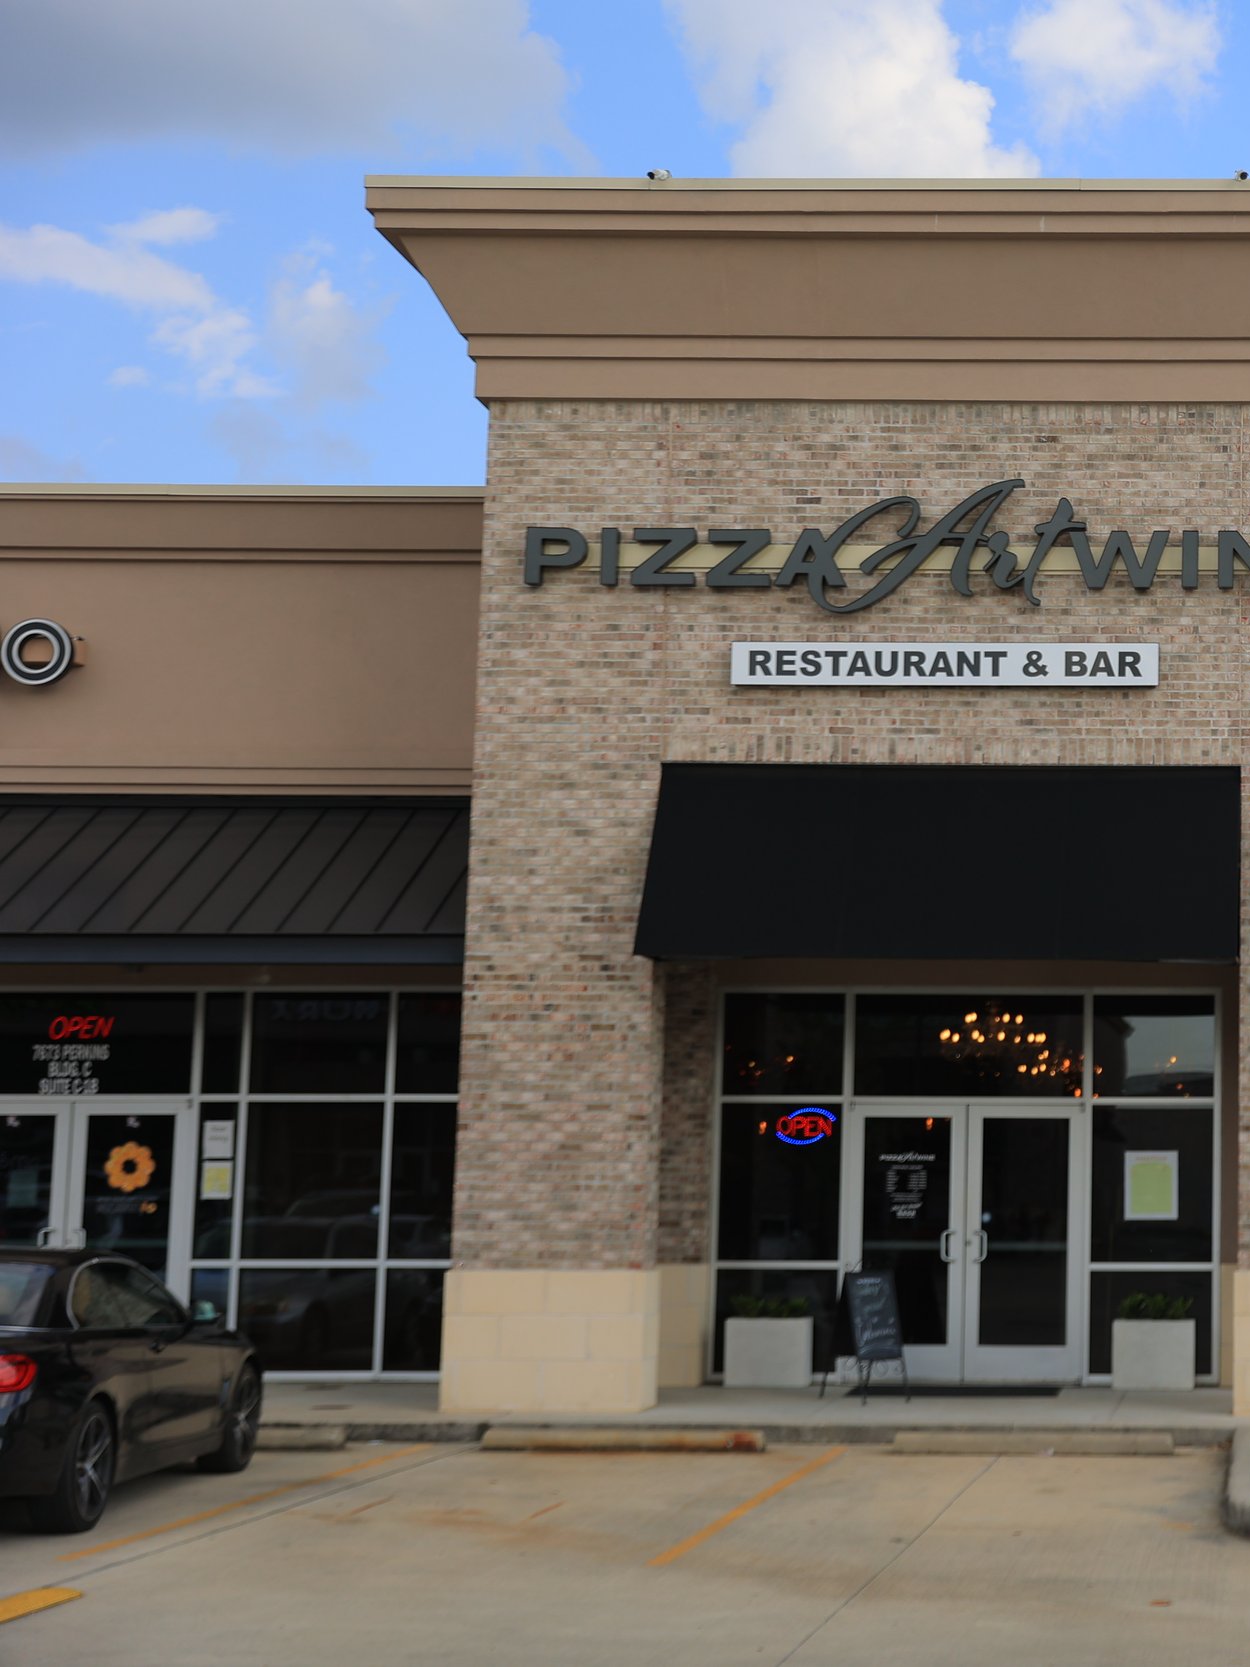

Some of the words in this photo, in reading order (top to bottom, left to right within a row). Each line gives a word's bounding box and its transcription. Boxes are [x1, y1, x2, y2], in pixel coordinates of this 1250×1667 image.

[523, 526, 847, 588] PIZZA
[807, 478, 1087, 613] Art
[748, 650, 1008, 678] RESTAURANT
[1022, 650, 1049, 678] &
[1064, 650, 1142, 678] BAR
[48, 1015, 115, 1040] OPEN
[81, 1061, 93, 1078] C
[776, 1115, 833, 1137] OPEN
